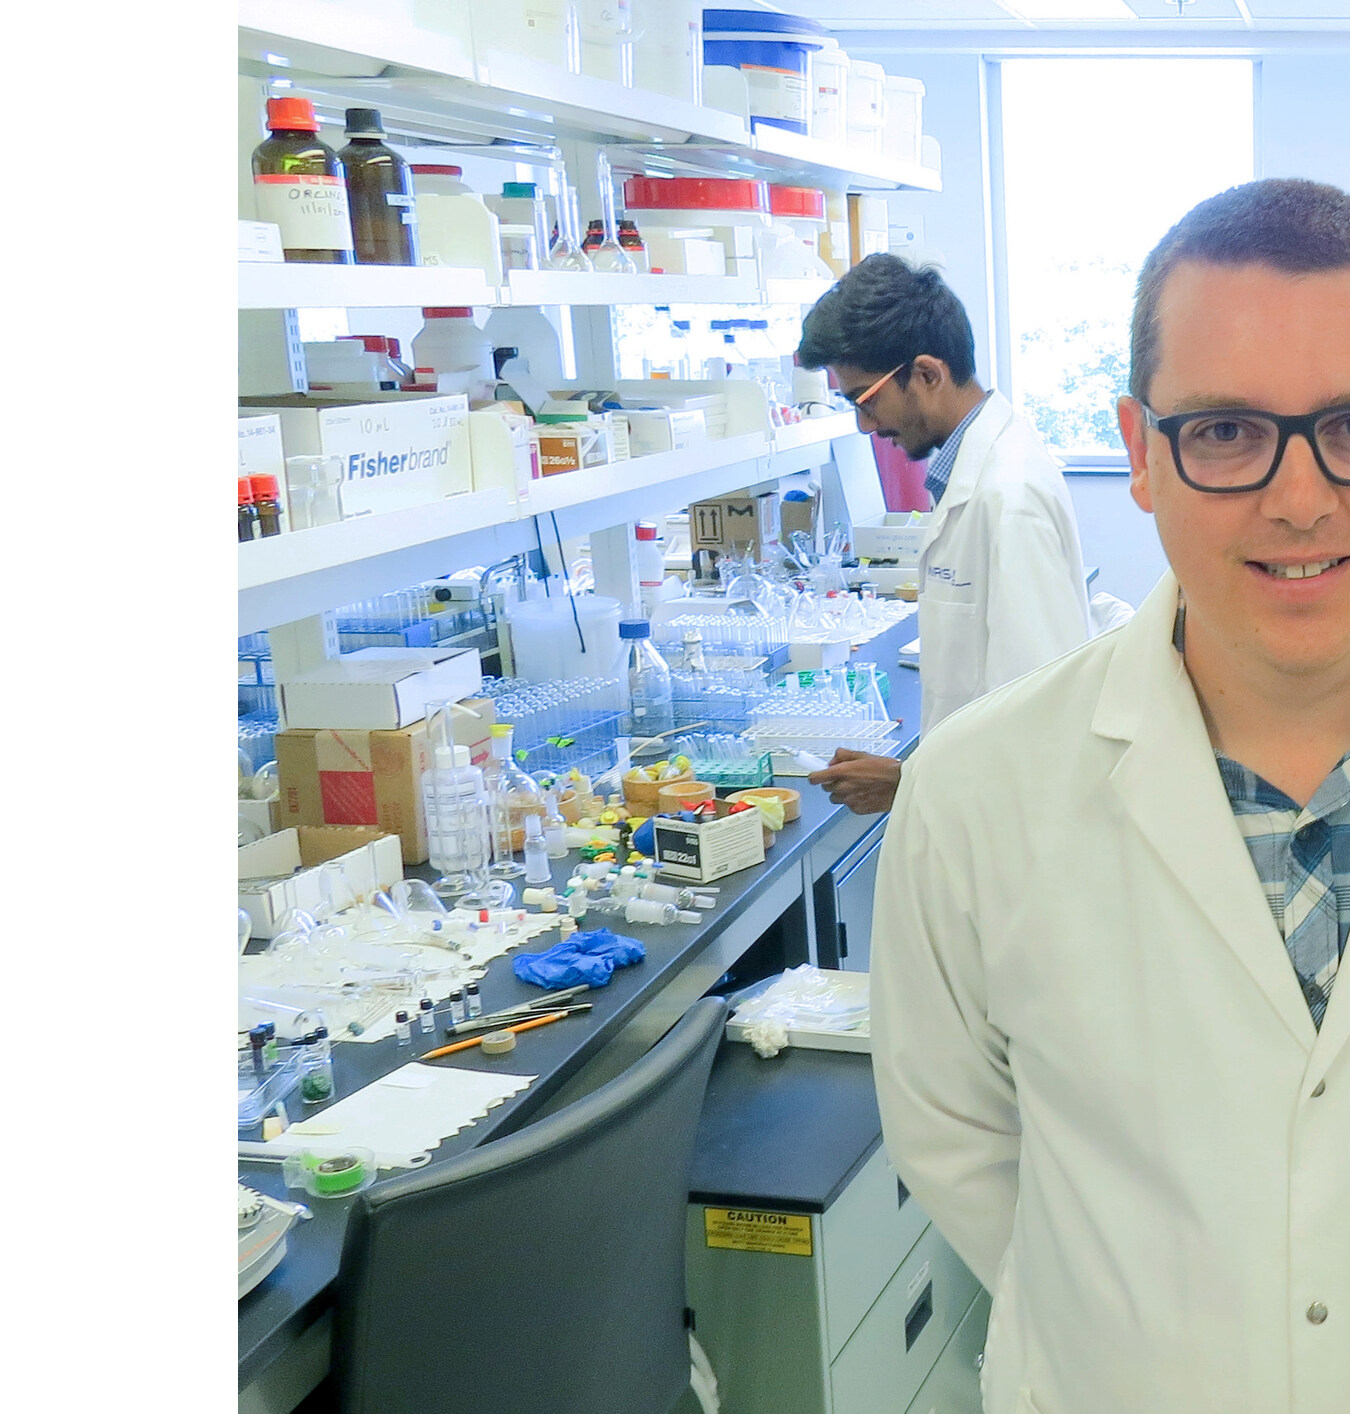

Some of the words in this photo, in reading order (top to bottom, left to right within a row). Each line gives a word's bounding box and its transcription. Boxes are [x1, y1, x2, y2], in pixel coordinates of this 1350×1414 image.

[360, 418, 373, 434] 10
[348, 440, 450, 481] Fisherbrand
[727, 1211, 787, 1225] CAUTION
